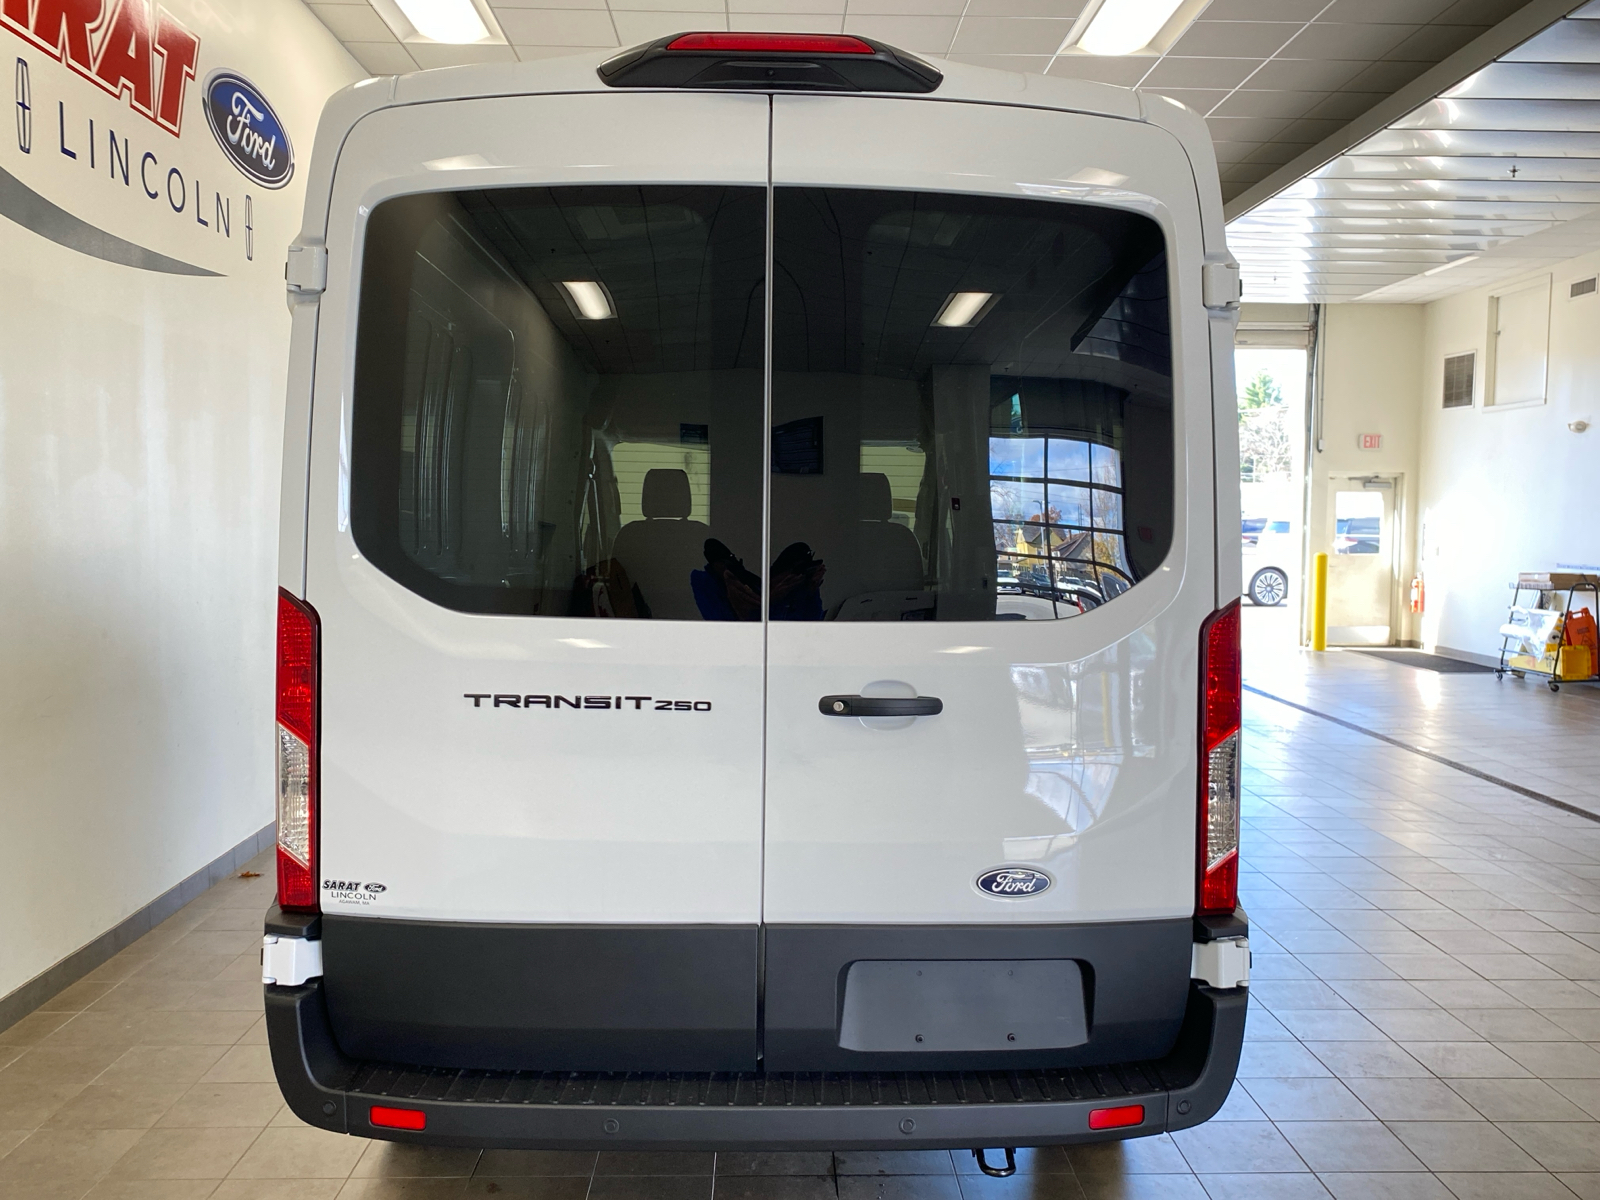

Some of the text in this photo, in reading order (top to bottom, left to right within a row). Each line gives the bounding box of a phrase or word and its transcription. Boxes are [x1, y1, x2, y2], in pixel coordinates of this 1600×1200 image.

[0, 0, 200, 138] RAT
[226, 91, 276, 171] Ford
[58, 100, 230, 238] LINCOLN
[1363, 434, 1381, 449] EXIT
[463, 693, 712, 712] TRANSIT 250
[322, 879, 361, 892] SARAT
[991, 873, 1037, 892] Ford
[331, 891, 376, 900] LINCOLN
